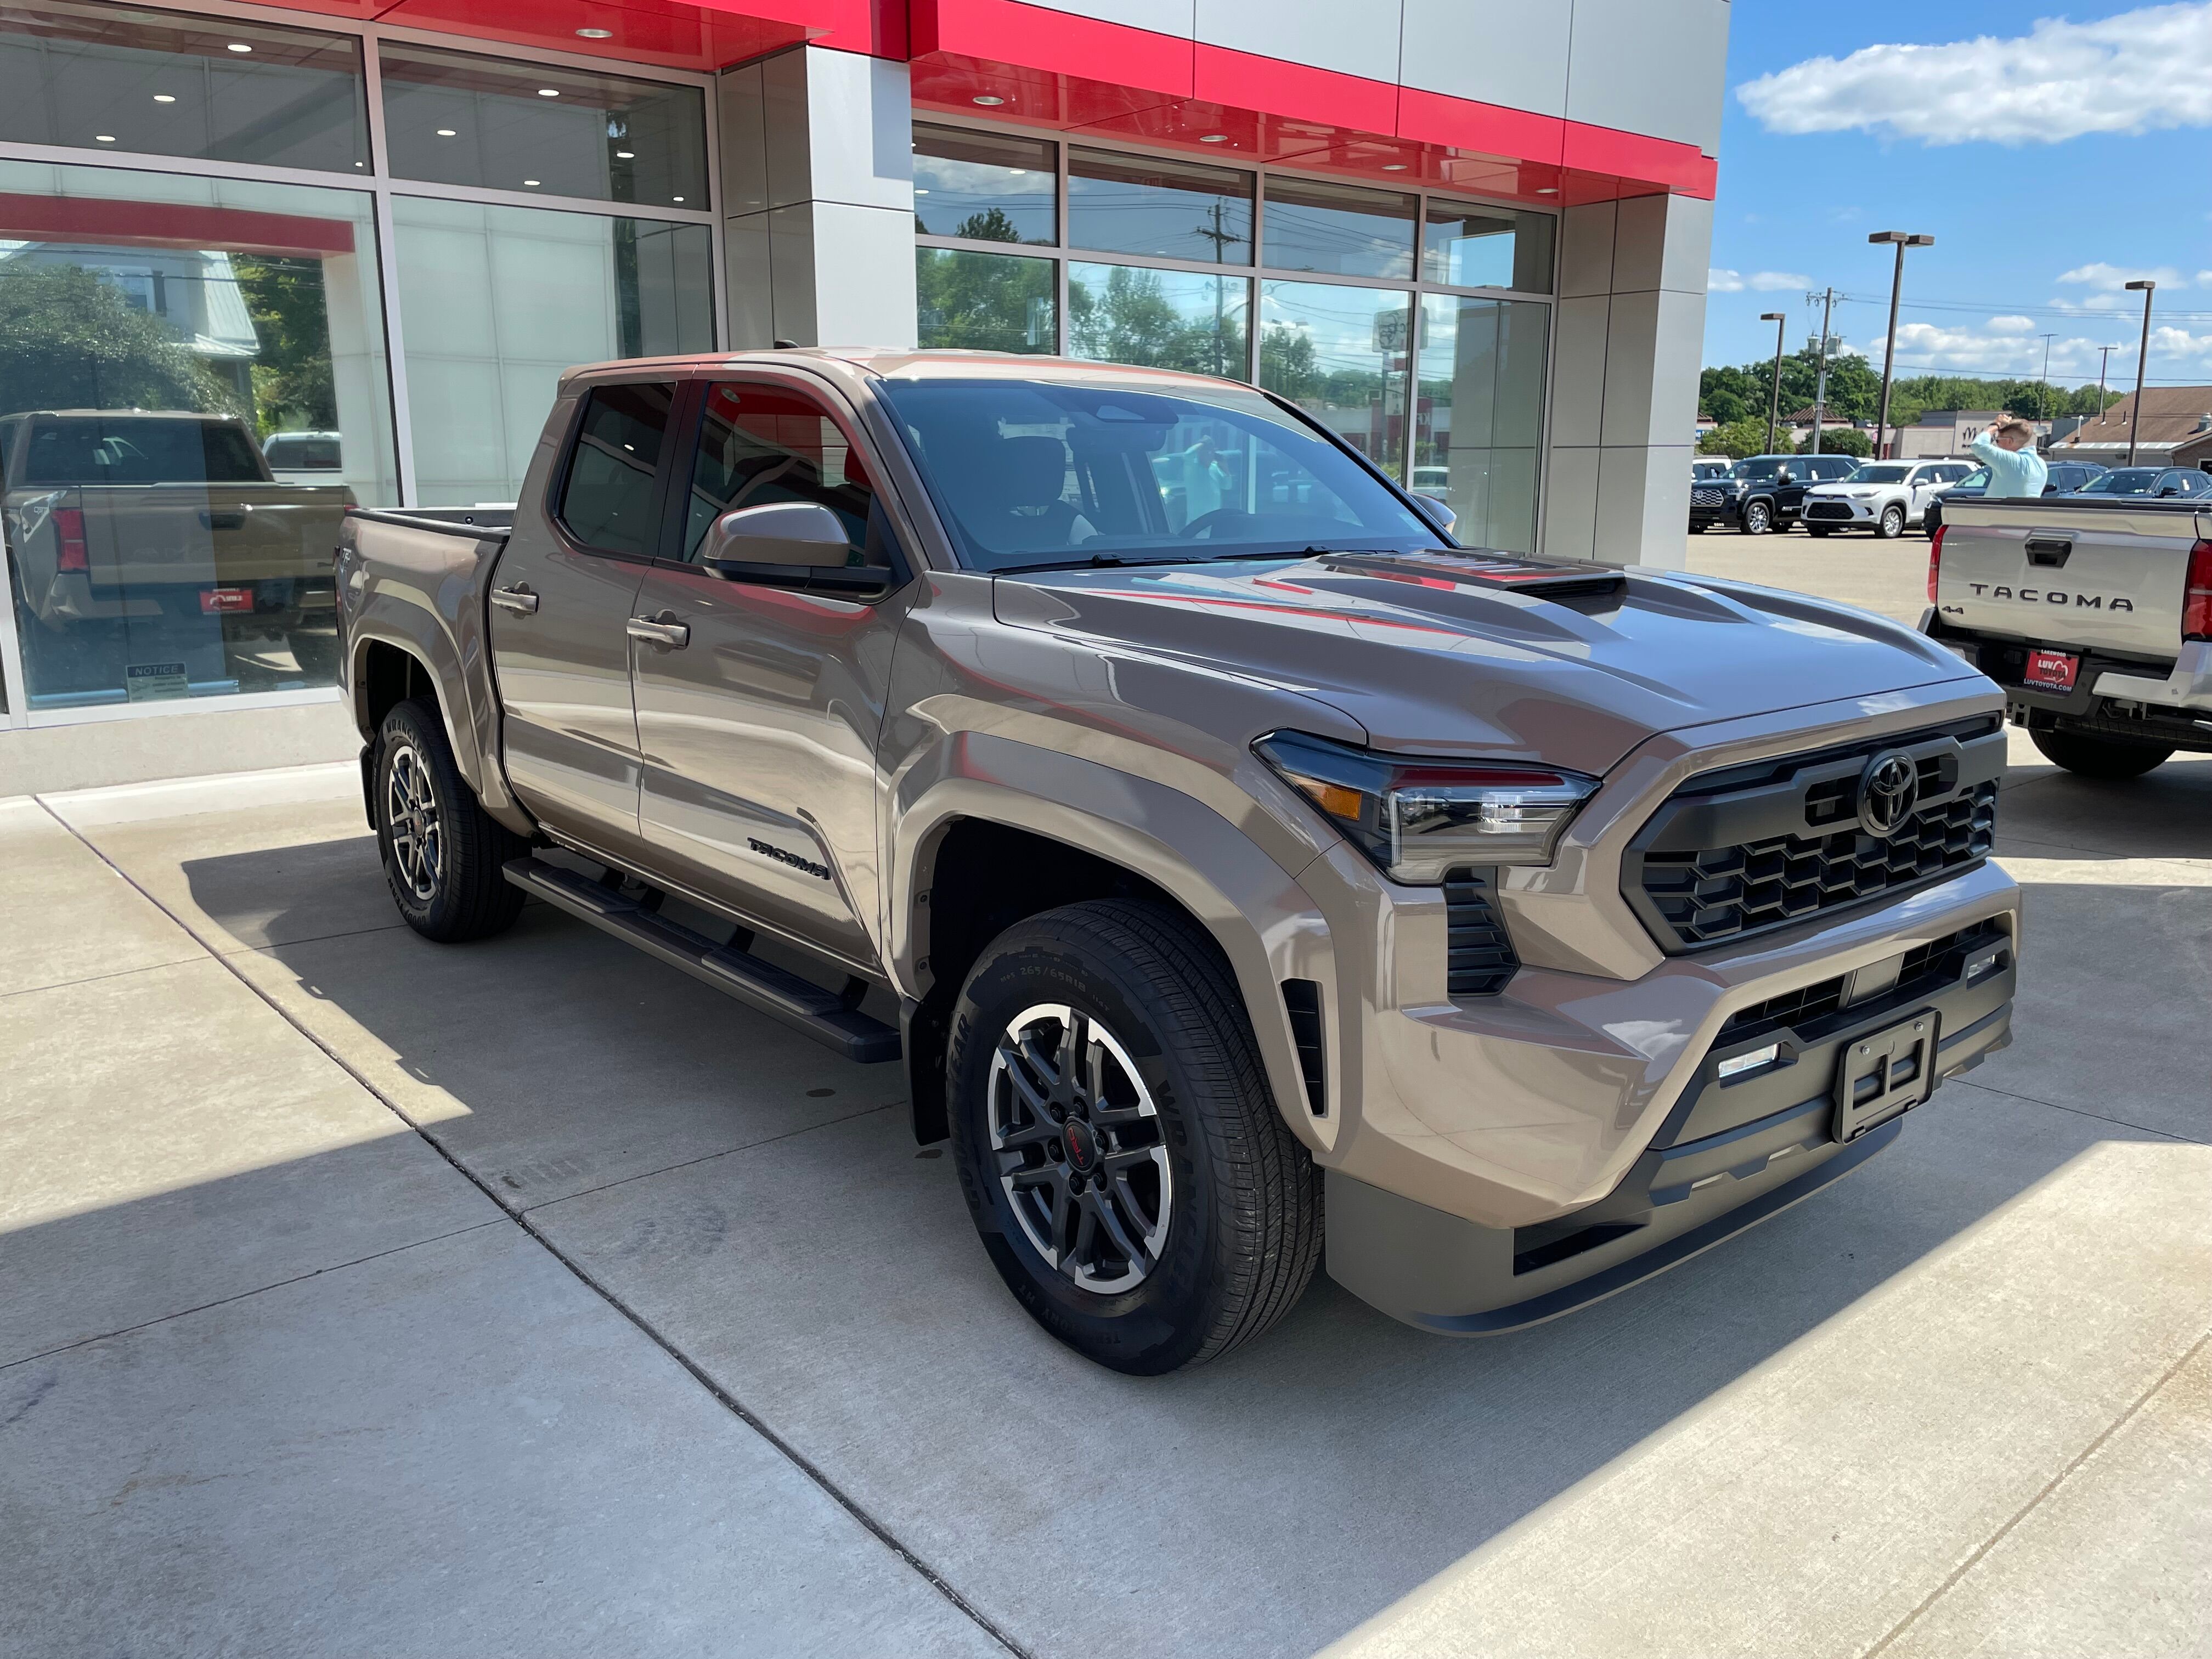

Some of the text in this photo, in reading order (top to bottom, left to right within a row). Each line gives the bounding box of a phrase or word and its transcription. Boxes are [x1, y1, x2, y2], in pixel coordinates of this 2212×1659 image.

[1970, 583, 2134, 613] TACOMA
[2041, 649, 2067, 657] LAKEWOOD
[135, 664, 178, 676] NOTICE
[2038, 659, 2054, 669] LUV
[2040, 668, 2067, 679] TOYOTA
[2023, 678, 2072, 692] LUVTOYOTA.COM
[747, 837, 832, 881] TACOMA
[1019, 965, 1087, 993] 265/65R18
